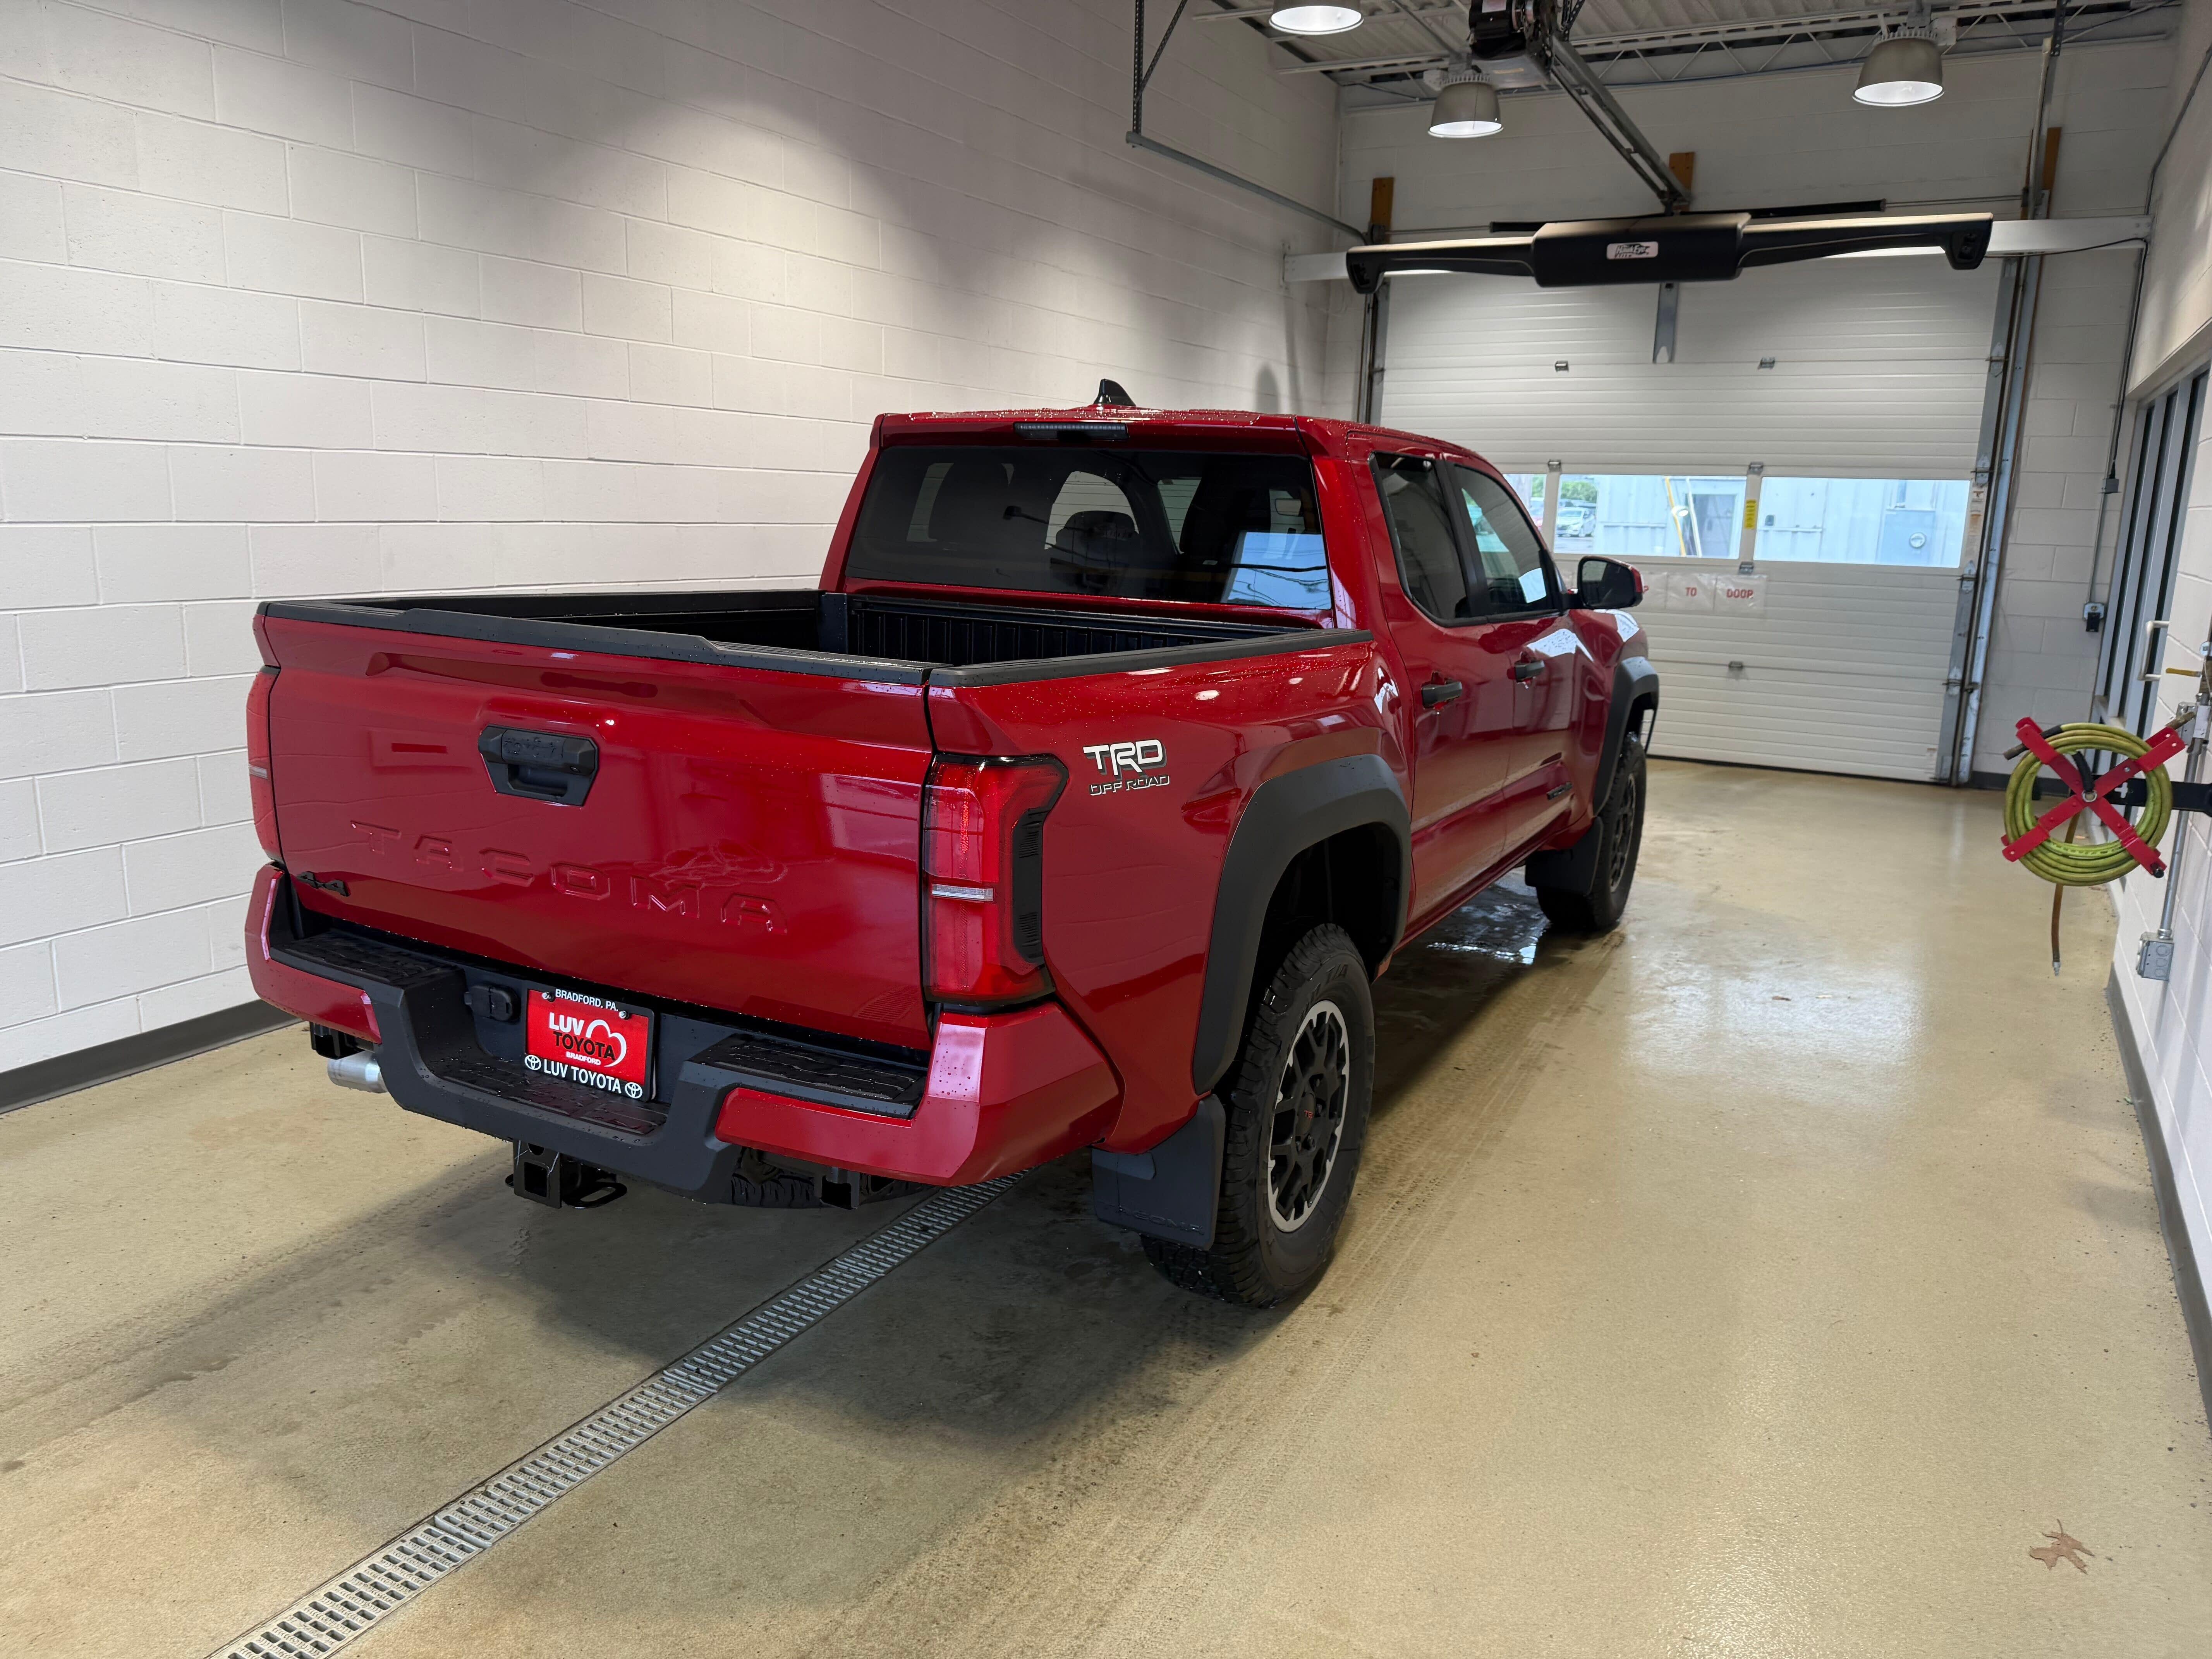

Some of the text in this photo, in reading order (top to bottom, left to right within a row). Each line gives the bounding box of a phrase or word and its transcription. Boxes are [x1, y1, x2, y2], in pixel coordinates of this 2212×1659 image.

[1686, 587, 1697, 596] TO
[1083, 739, 1166, 778] TRD
[1089, 775, 1170, 796] OFF ROAD
[350, 820, 788, 934] TACOMA
[555, 988, 619, 1012] BRADFORD, PA.
[549, 1012, 585, 1036] LUV
[553, 1031, 615, 1061] TOYOTA
[566, 1051, 601, 1066] BRADFORD
[544, 1059, 622, 1094] LUV TOYOTA
